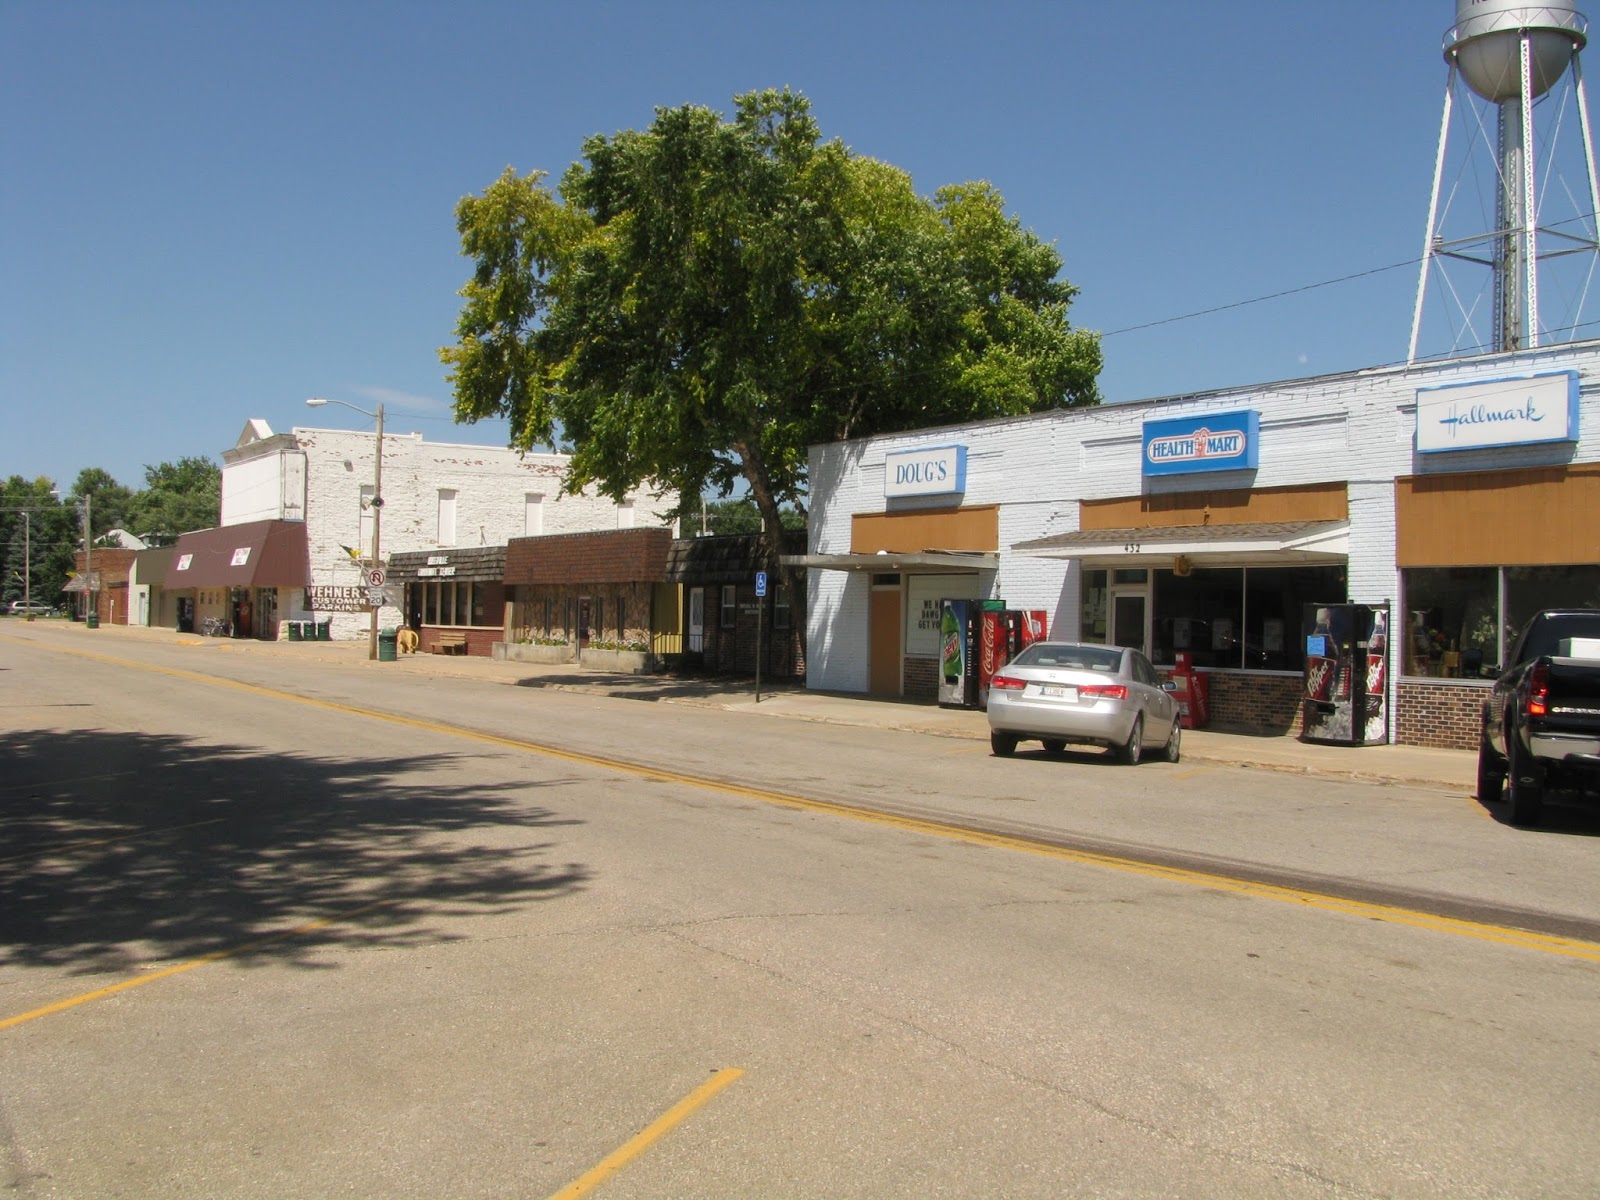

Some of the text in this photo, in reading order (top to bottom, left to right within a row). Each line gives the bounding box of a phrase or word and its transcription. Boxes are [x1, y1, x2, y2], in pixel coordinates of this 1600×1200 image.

[1439, 397, 1545, 438] Hallmark
[1153, 435, 1239, 458] HEALTH MART
[896, 460, 947, 484] DOUG'S
[1124, 543, 1141, 553] 432
[311, 597, 366, 605] CUSTOMER
[918, 620, 930, 629] GET
